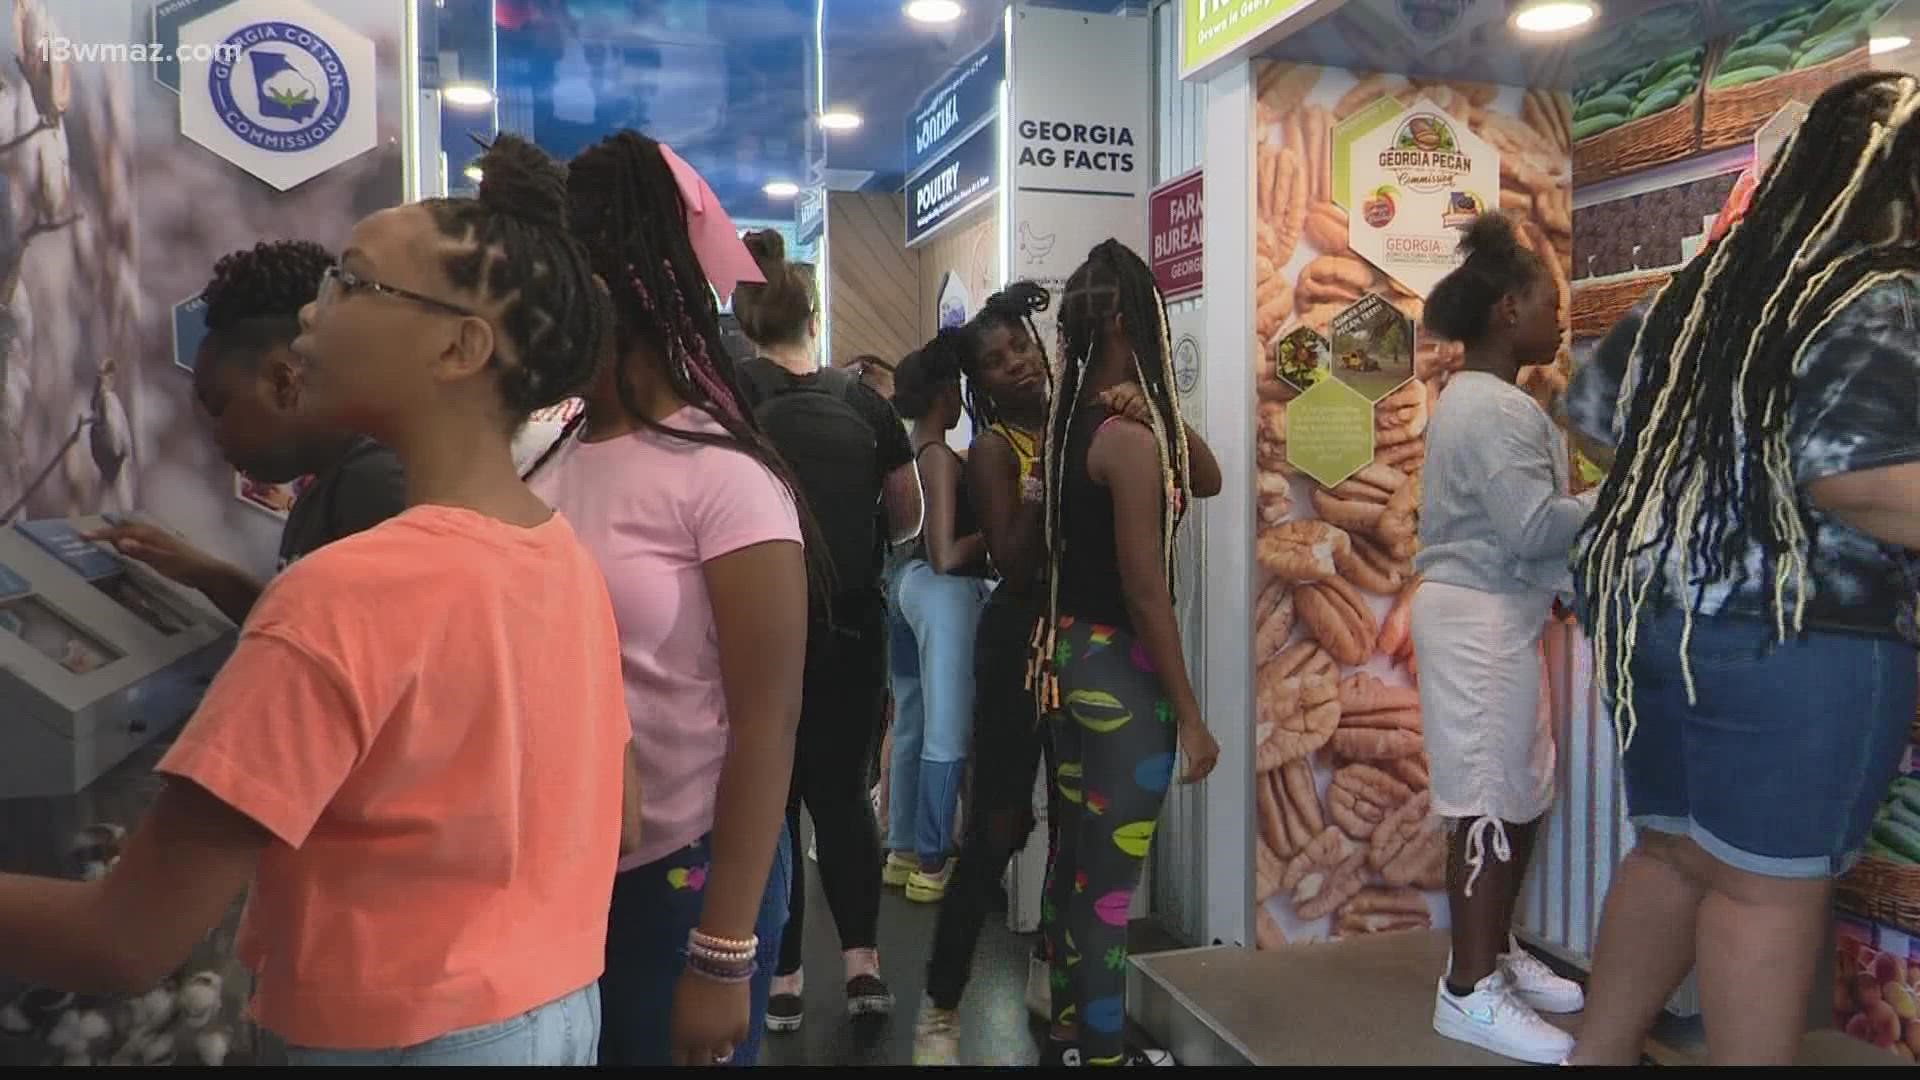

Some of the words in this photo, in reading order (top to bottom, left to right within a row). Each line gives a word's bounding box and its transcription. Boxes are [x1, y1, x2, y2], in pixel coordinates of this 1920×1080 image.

[215, 25, 277, 79] GRGIA
[284, 28, 344, 87] COTTON
[226, 111, 338, 149] COMMISSION
[1018, 120, 1134, 146] GEORGIA
[1018, 147, 1056, 167] AG
[1063, 149, 1134, 172] FACTS
[1378, 152, 1430, 166] GEORGIA
[1432, 153, 1471, 173] PECAN
[916, 160, 960, 215] POULTRY
[1397, 171, 1456, 187] Commission
[1154, 222, 1203, 259] BUREA
[1386, 237, 1441, 253] GEORGIA
